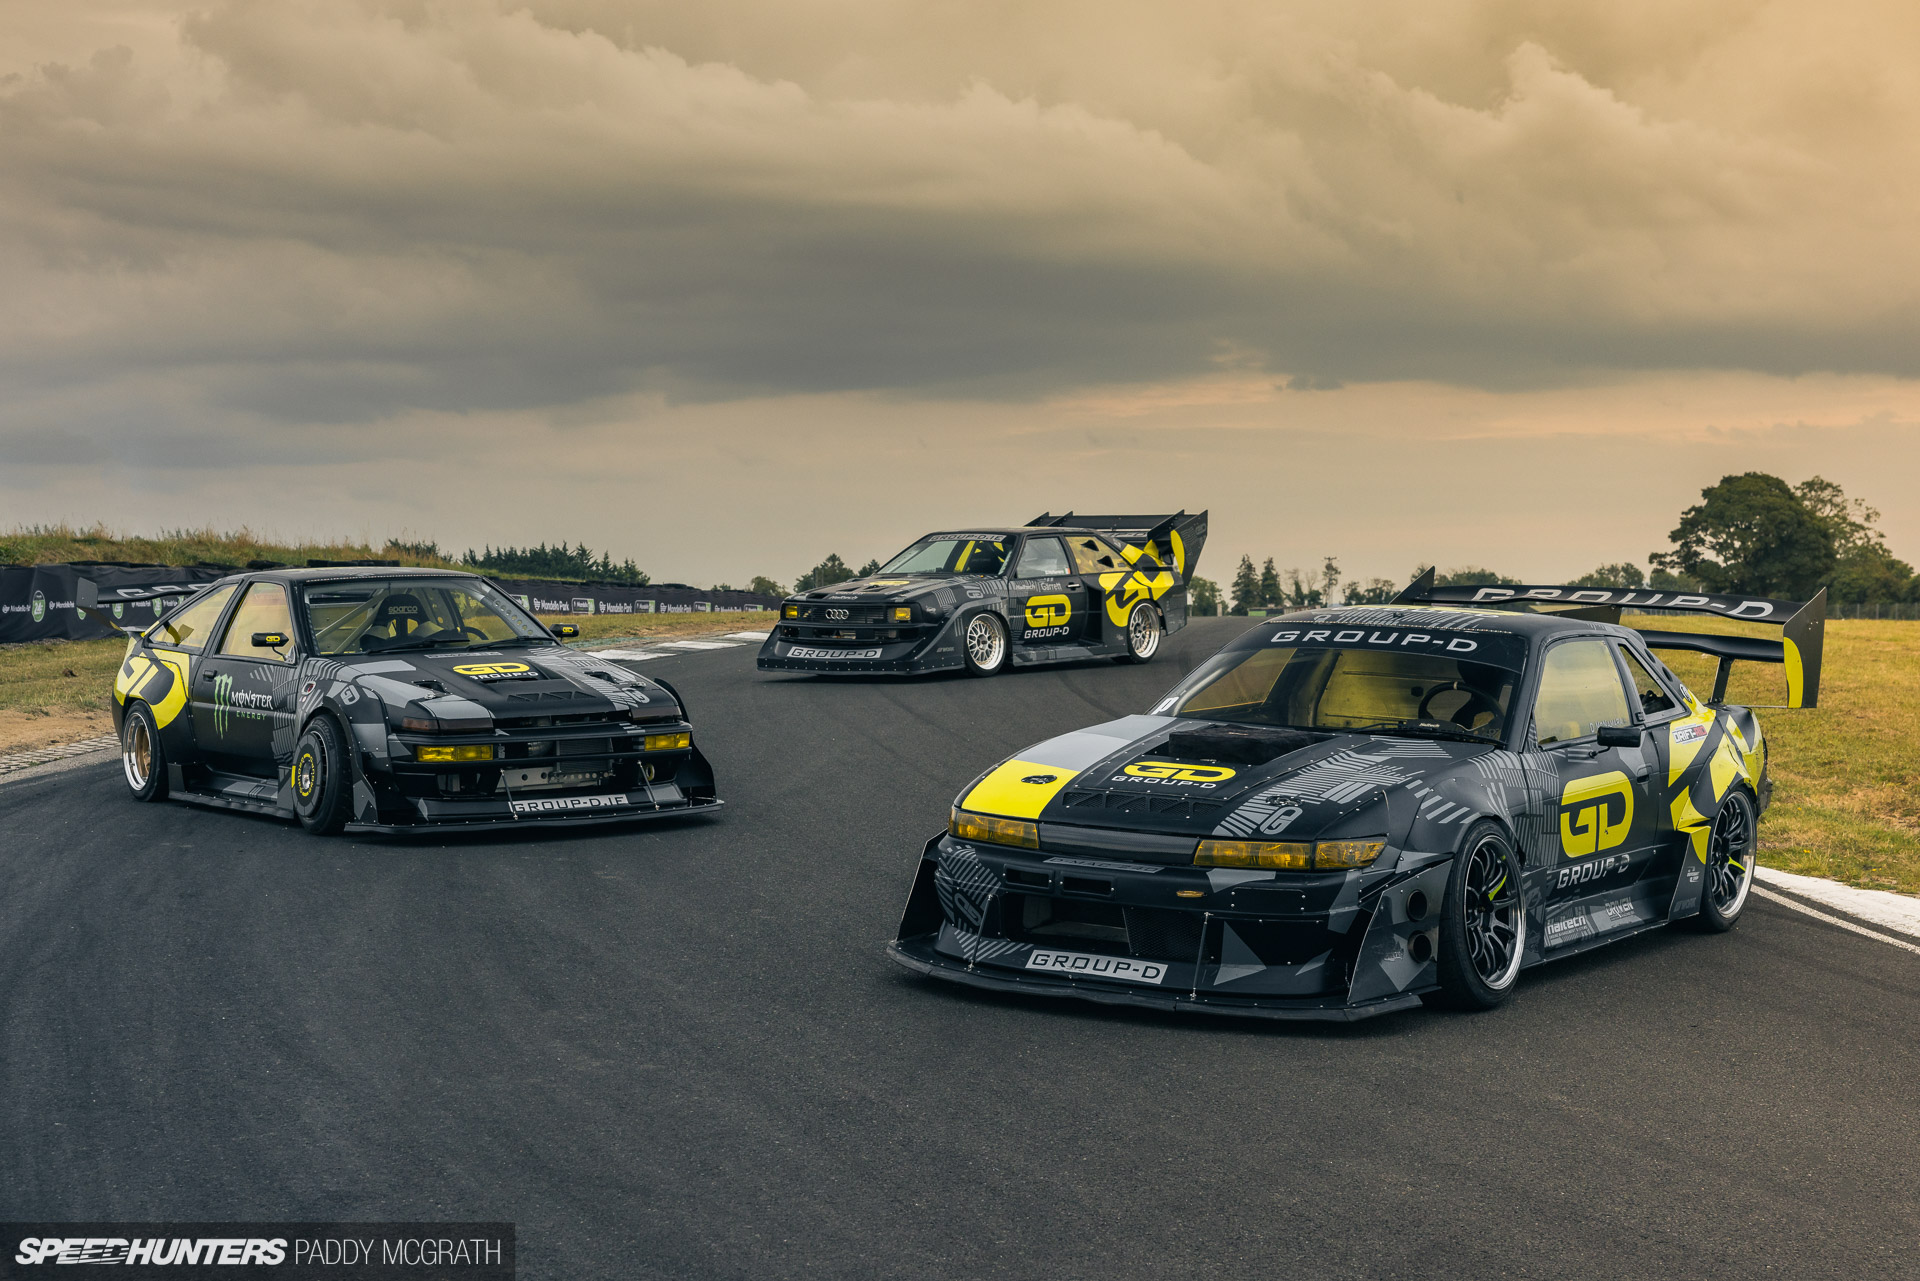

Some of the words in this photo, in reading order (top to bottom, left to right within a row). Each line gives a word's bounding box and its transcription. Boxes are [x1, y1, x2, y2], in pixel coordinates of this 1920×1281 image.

[389, 605, 418, 613] sparco
[560, 601, 569, 611] Park
[1024, 626, 1070, 639] GROUP-D
[1270, 630, 1478, 652] GROUP-D
[791, 648, 878, 658] GROUP-D
[236, 710, 267, 721] ENERGY
[1124, 761, 1237, 782] GD
[1111, 775, 1217, 789] GROUP-D
[514, 796, 625, 812] GROUP-D.IE
[1560, 770, 1634, 858] GD
[1557, 854, 1630, 889] GROUP-D
[1032, 953, 1161, 980] GROUP-D
